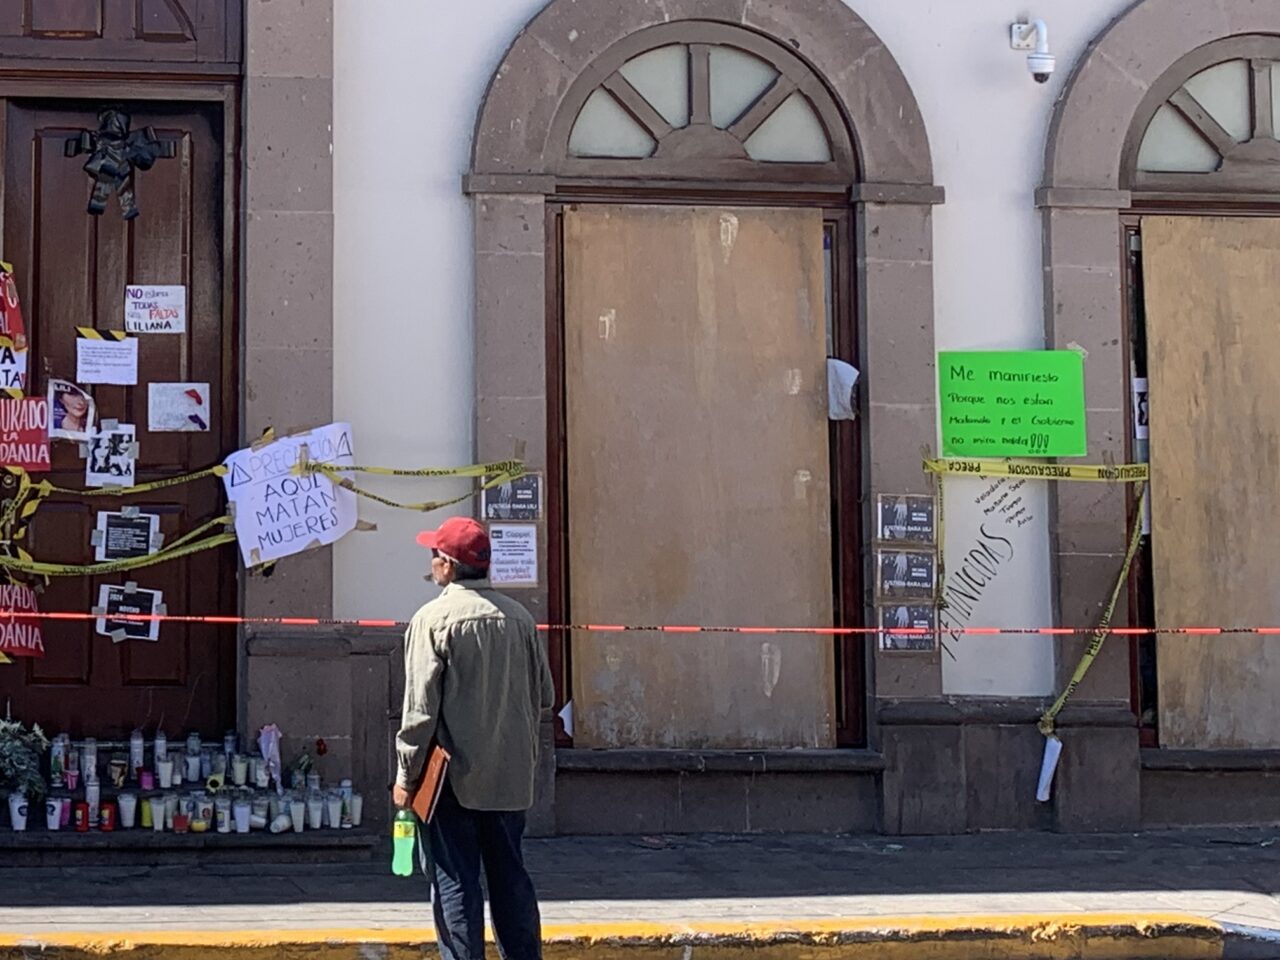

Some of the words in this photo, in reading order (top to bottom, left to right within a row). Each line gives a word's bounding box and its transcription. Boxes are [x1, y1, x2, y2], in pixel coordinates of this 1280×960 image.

[127, 288, 144, 300] NO
[127, 320, 172, 332] LILIANA
[950, 365, 976, 381] Me
[996, 396, 1016, 406] nos
[3, 431, 19, 442] LA
[951, 437, 965, 446] no
[1007, 464, 1072, 477] PRECAUCION
[256, 490, 337, 527] MATAN
[257, 506, 339, 551] MUJERES
